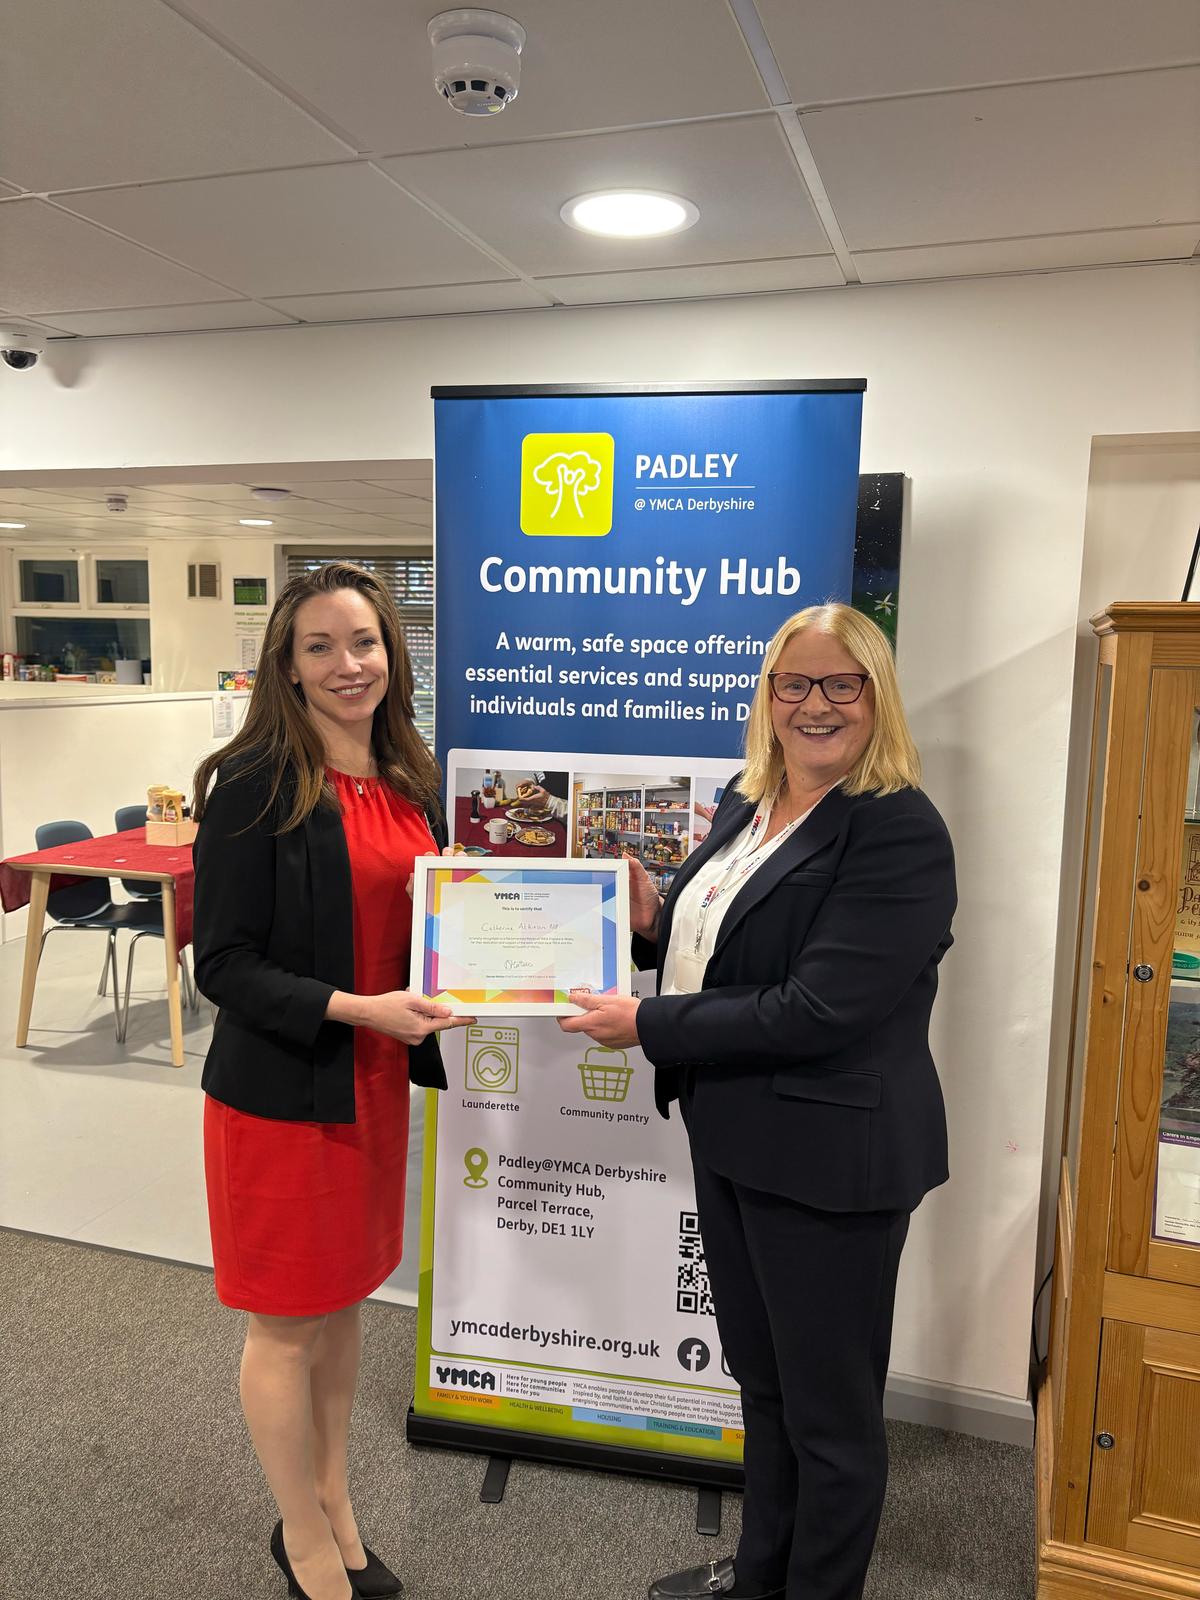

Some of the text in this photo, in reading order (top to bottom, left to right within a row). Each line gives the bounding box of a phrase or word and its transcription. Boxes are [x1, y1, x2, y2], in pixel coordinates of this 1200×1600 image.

[634, 453, 739, 479] PADLEY
[634, 498, 755, 513] @ YMCA Derbyshire
[479, 556, 801, 606] Community Hub
[496, 632, 510, 650] A
[515, 635, 577, 655] warm,
[582, 633, 624, 653] safe
[630, 638, 688, 658] space
[465, 664, 760, 693] essential services and suppor
[470, 694, 576, 716] individuals
[581, 698, 618, 718] and
[624, 699, 705, 721] families
[711, 701, 729, 721] in
[494, 892, 520, 900] YMCA
[462, 1099, 520, 1112] Launderette
[560, 1106, 650, 1125] Community pantry
[498, 1154, 667, 1183] Padley@YMCA Derbyshire
[498, 1175, 605, 1199] Community Hub,
[497, 1196, 594, 1220] Parcel Terrace,
[496, 1217, 595, 1239] Derby, DE1 1LY
[450, 1318, 660, 1359] ymcaderbyshire.org.uk
[436, 1366, 496, 1391] YMCA
[530, 1377, 547, 1385] young
[548, 1380, 567, 1388] people
[460, 1394, 477, 1402] YOUTH
[530, 1384, 566, 1393] communities
[509, 1401, 529, 1409] HEALTH
[573, 1389, 593, 1397] Inspired
[650, 1399, 672, 1409] Christian
[633, 1391, 653, 1399] develop
[677, 1396, 700, 1404] potential
[722, 1402, 736, 1410] body
[597, 1413, 622, 1423] HOUSING
[650, 1408, 667, 1416] young
[668, 1410, 685, 1418] people
[684, 1426, 716, 1435] EDUCATION
